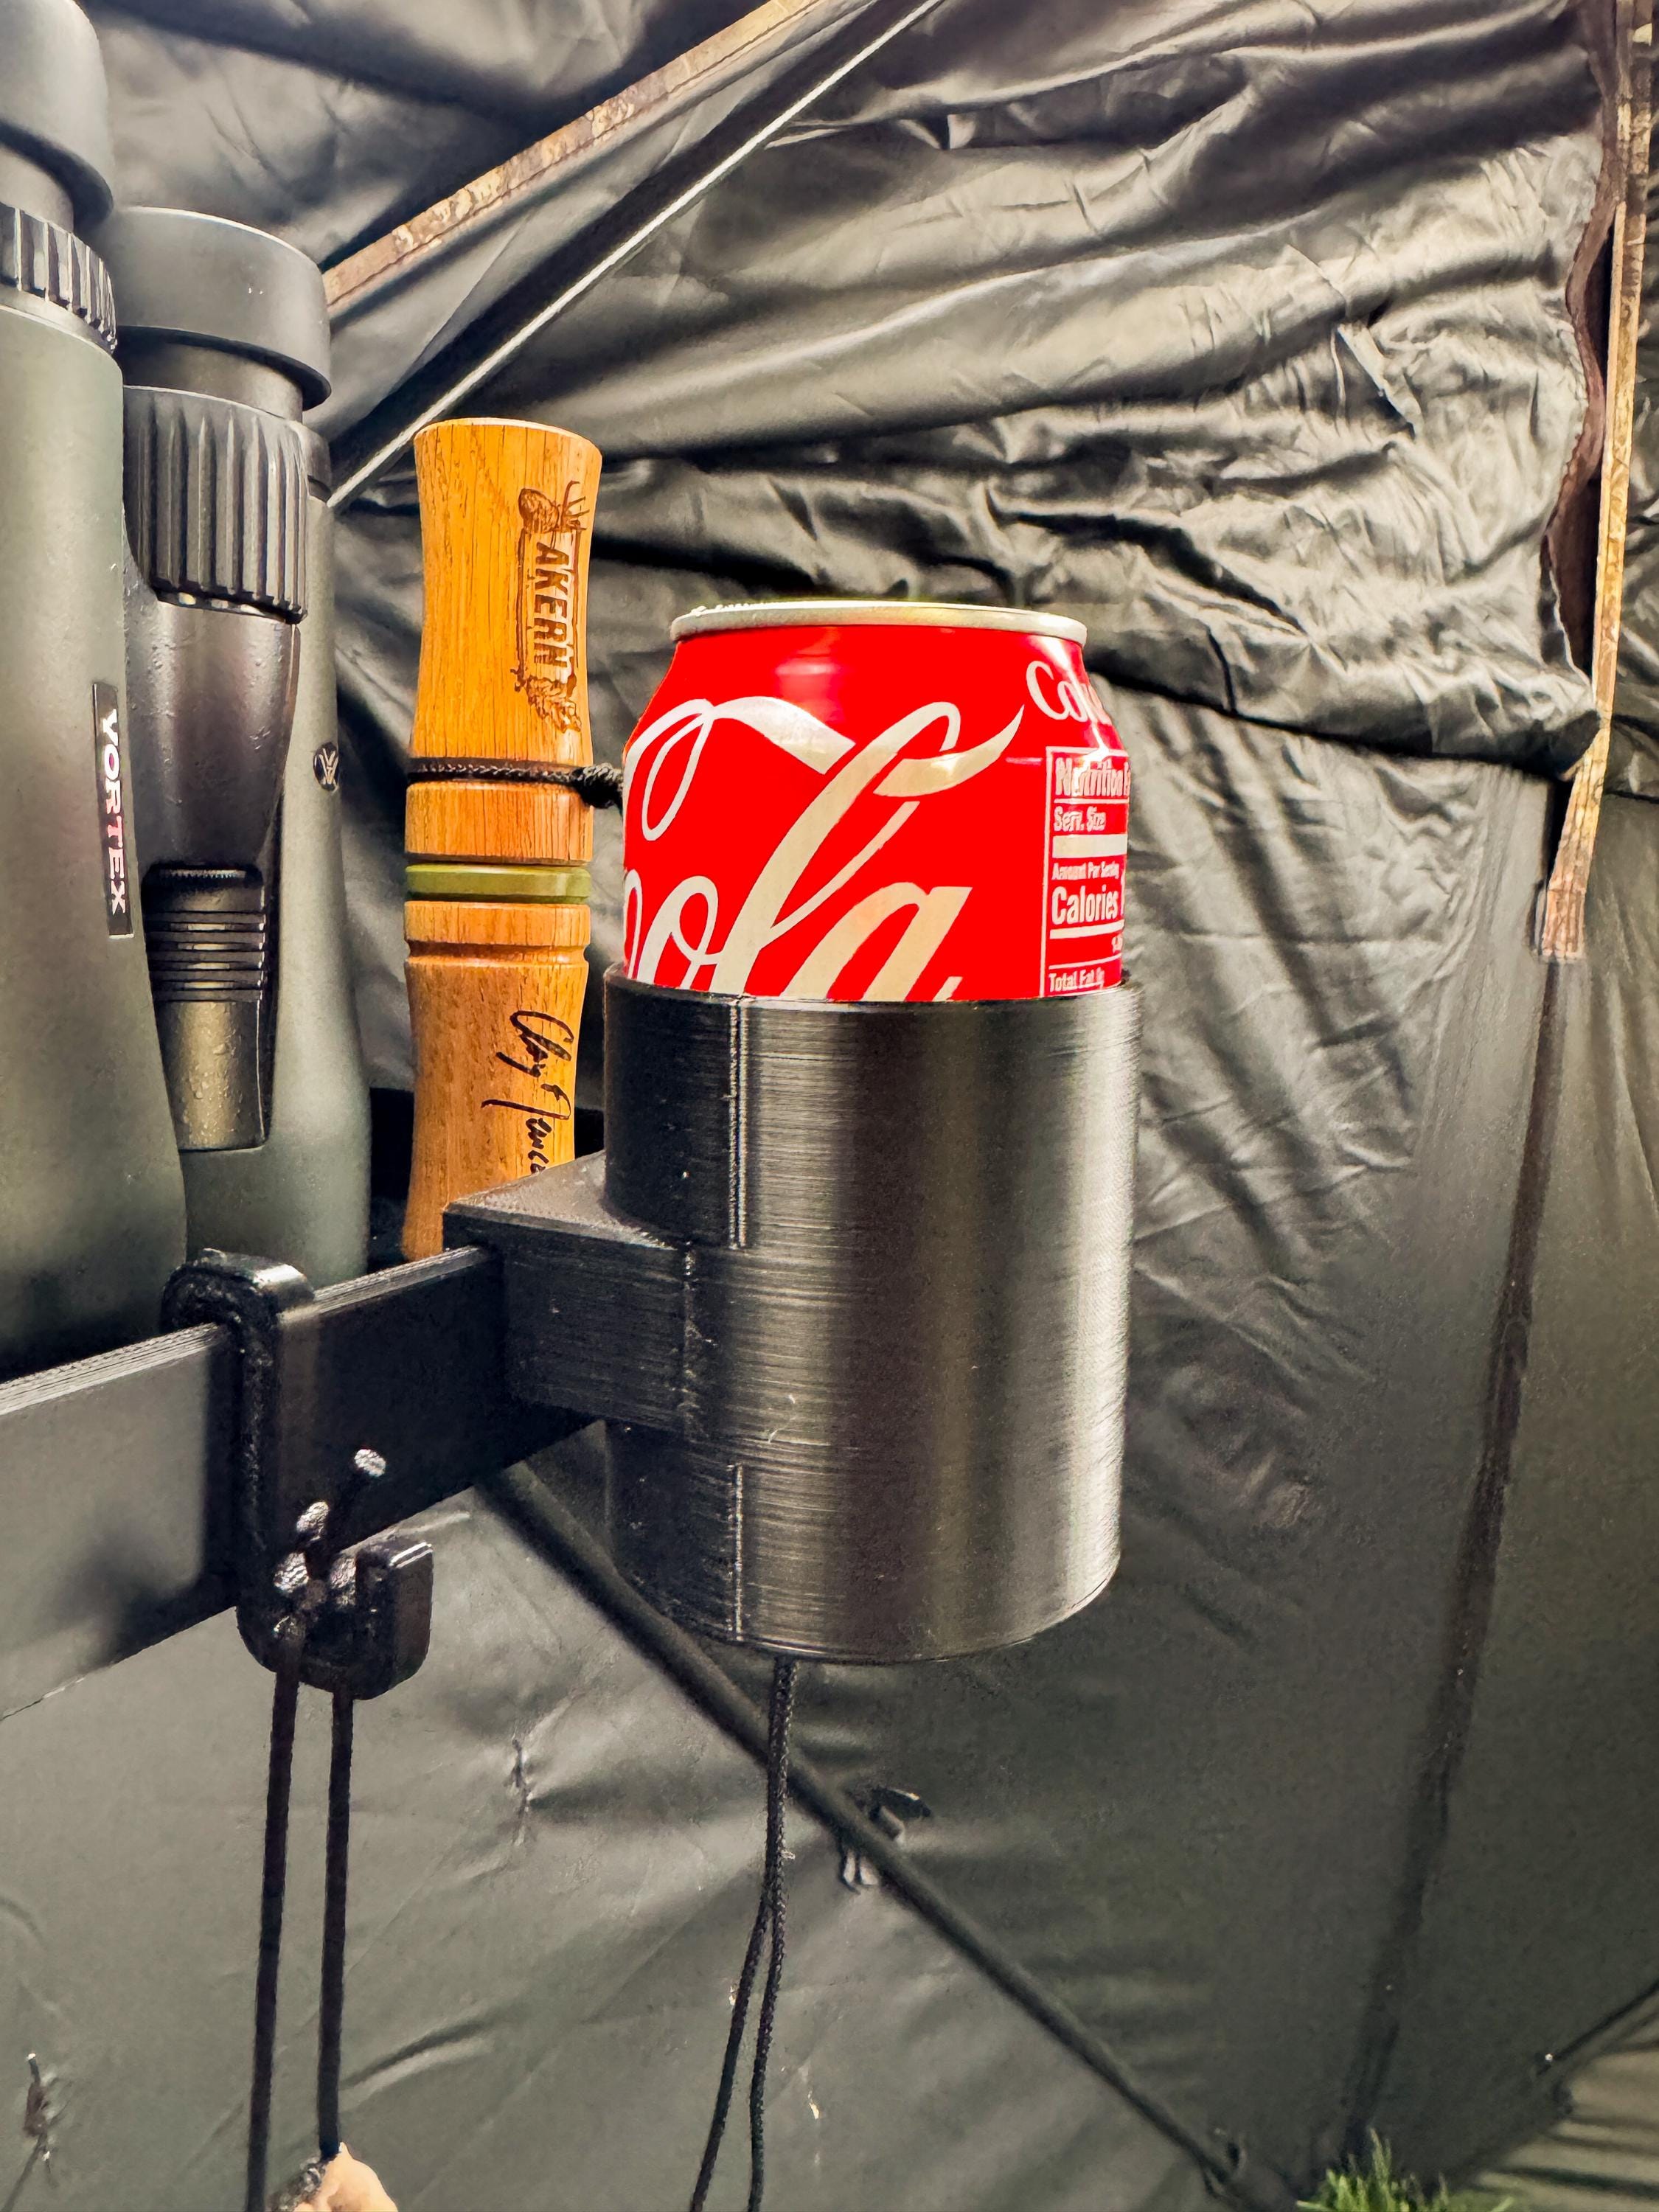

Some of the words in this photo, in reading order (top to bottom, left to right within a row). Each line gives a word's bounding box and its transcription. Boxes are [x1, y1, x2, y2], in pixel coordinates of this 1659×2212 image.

[102, 708, 126, 916] VORTEX
[1051, 884, 1119, 925] Calories
[1048, 971, 1078, 992] Total
